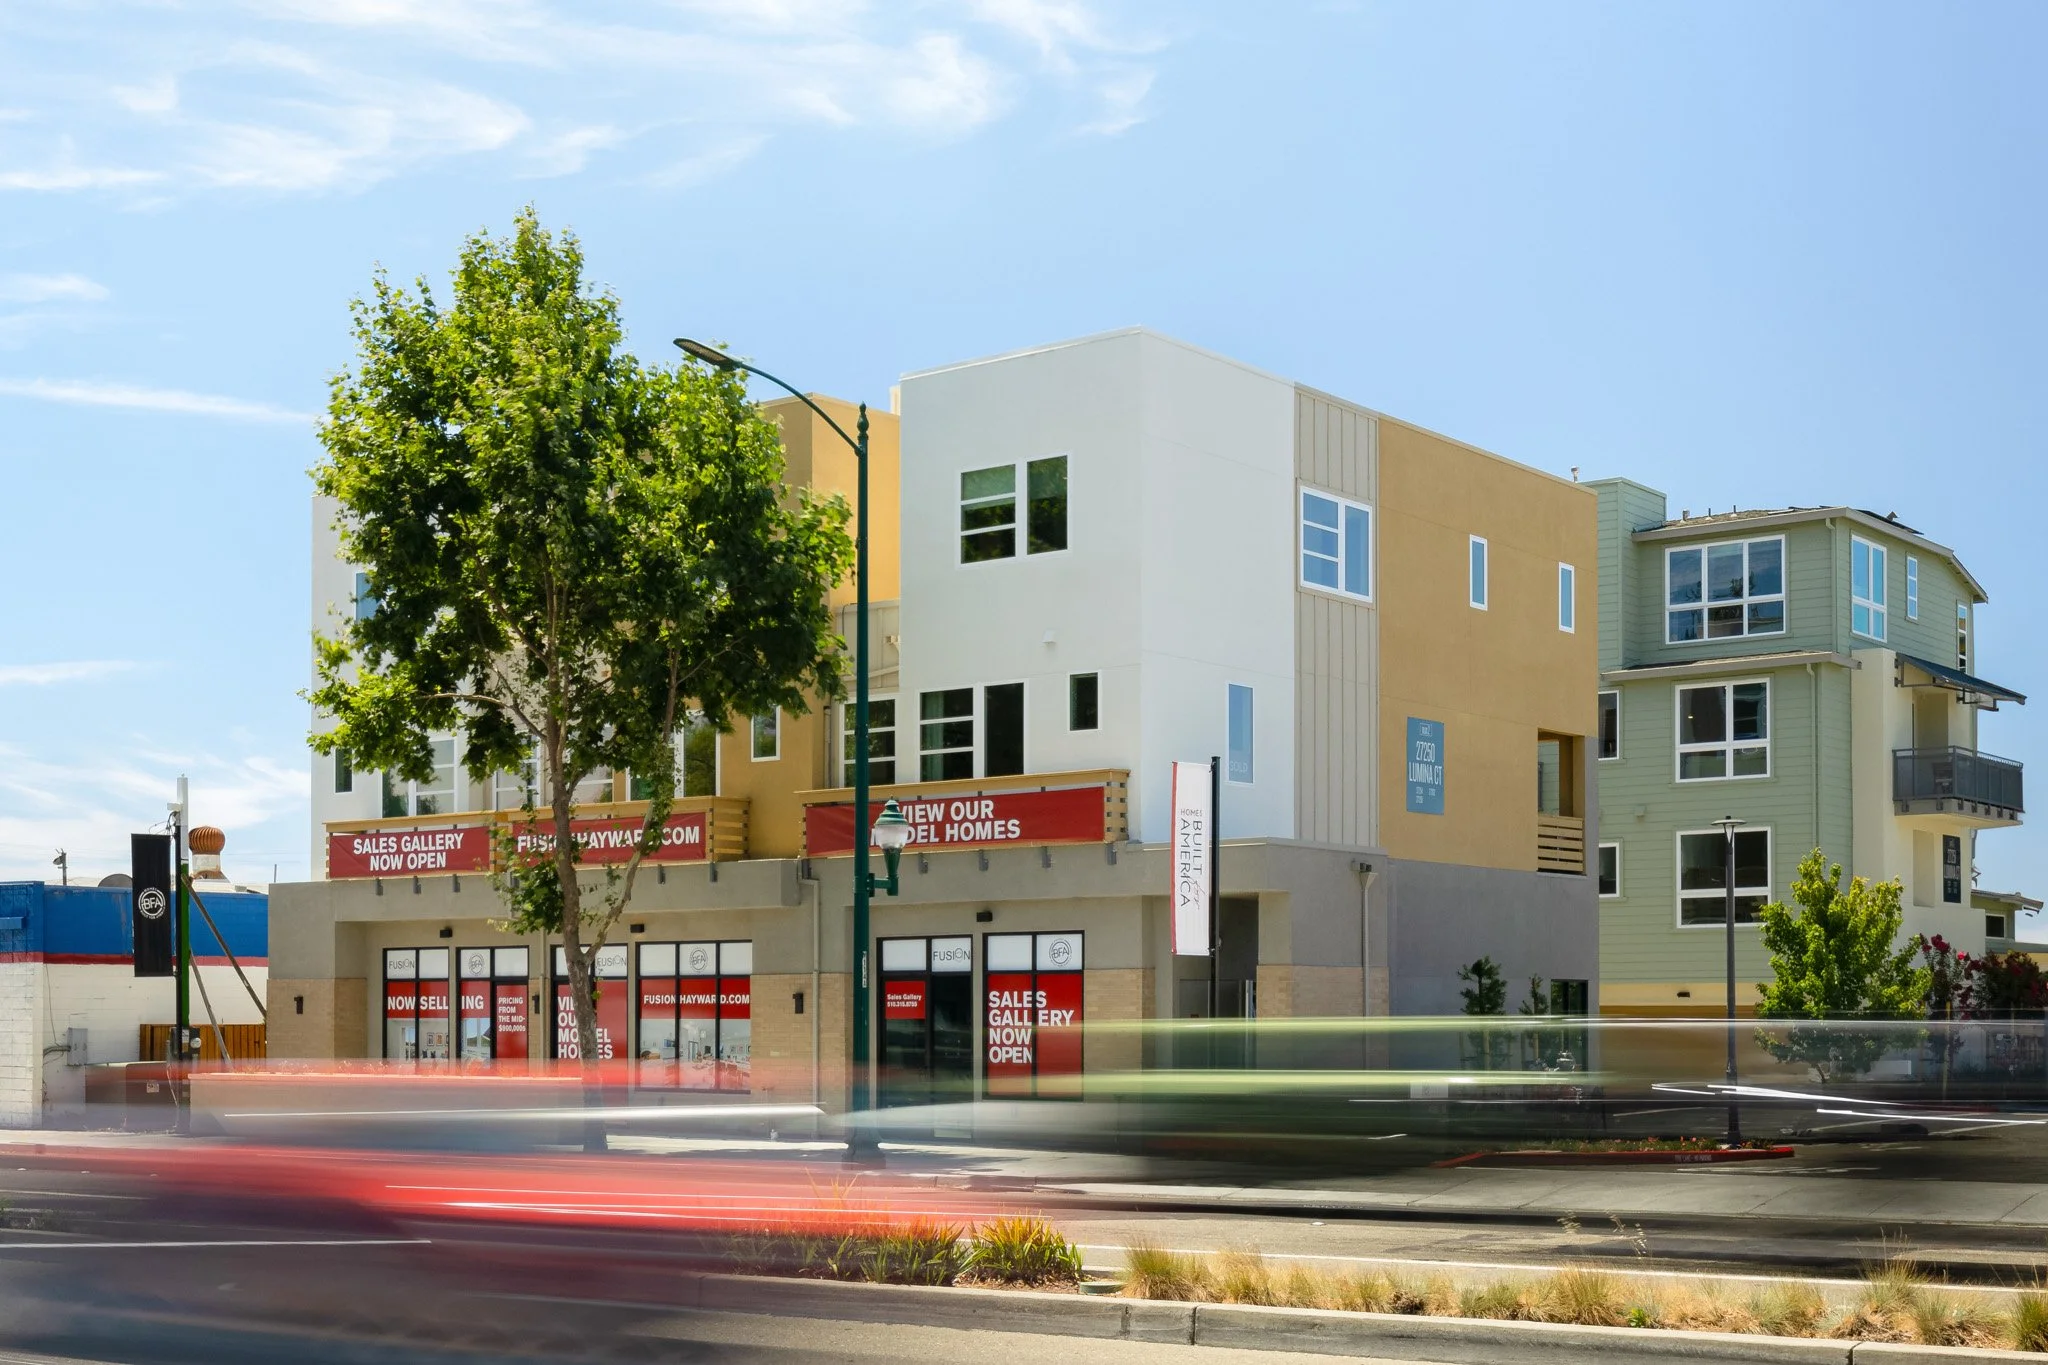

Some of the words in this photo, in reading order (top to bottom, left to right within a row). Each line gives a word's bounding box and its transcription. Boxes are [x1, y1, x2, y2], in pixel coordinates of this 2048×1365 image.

[1416, 741, 1435, 762] 27250
[1434, 765, 1443, 785] CT
[950, 800, 994, 821] OUR
[1180, 808, 1202, 817] HOMES
[870, 825, 939, 846] DEL
[945, 819, 1021, 842] HOMES
[353, 835, 398, 855] SALES
[400, 833, 464, 853] GALLERY
[1192, 820, 1202, 874] BUILT
[369, 853, 404, 872] NOW
[408, 851, 446, 870] OPEN
[1180, 818, 1191, 907] AMERICA
[144, 897, 163, 909] BFA
[388, 958, 415, 970] FUSION
[596, 954, 627, 967] FUSION
[932, 947, 971, 963] FUSION
[387, 996, 416, 1010] NOW
[498, 996, 524, 1004] PRICING
[988, 990, 1047, 1008] SALES
[988, 1009, 1075, 1027] GALLERY
[557, 1028, 612, 1042] MOEL
[988, 1028, 1033, 1045] NOW
[557, 1043, 613, 1059] HOES
[988, 1046, 1033, 1064] OPEN
